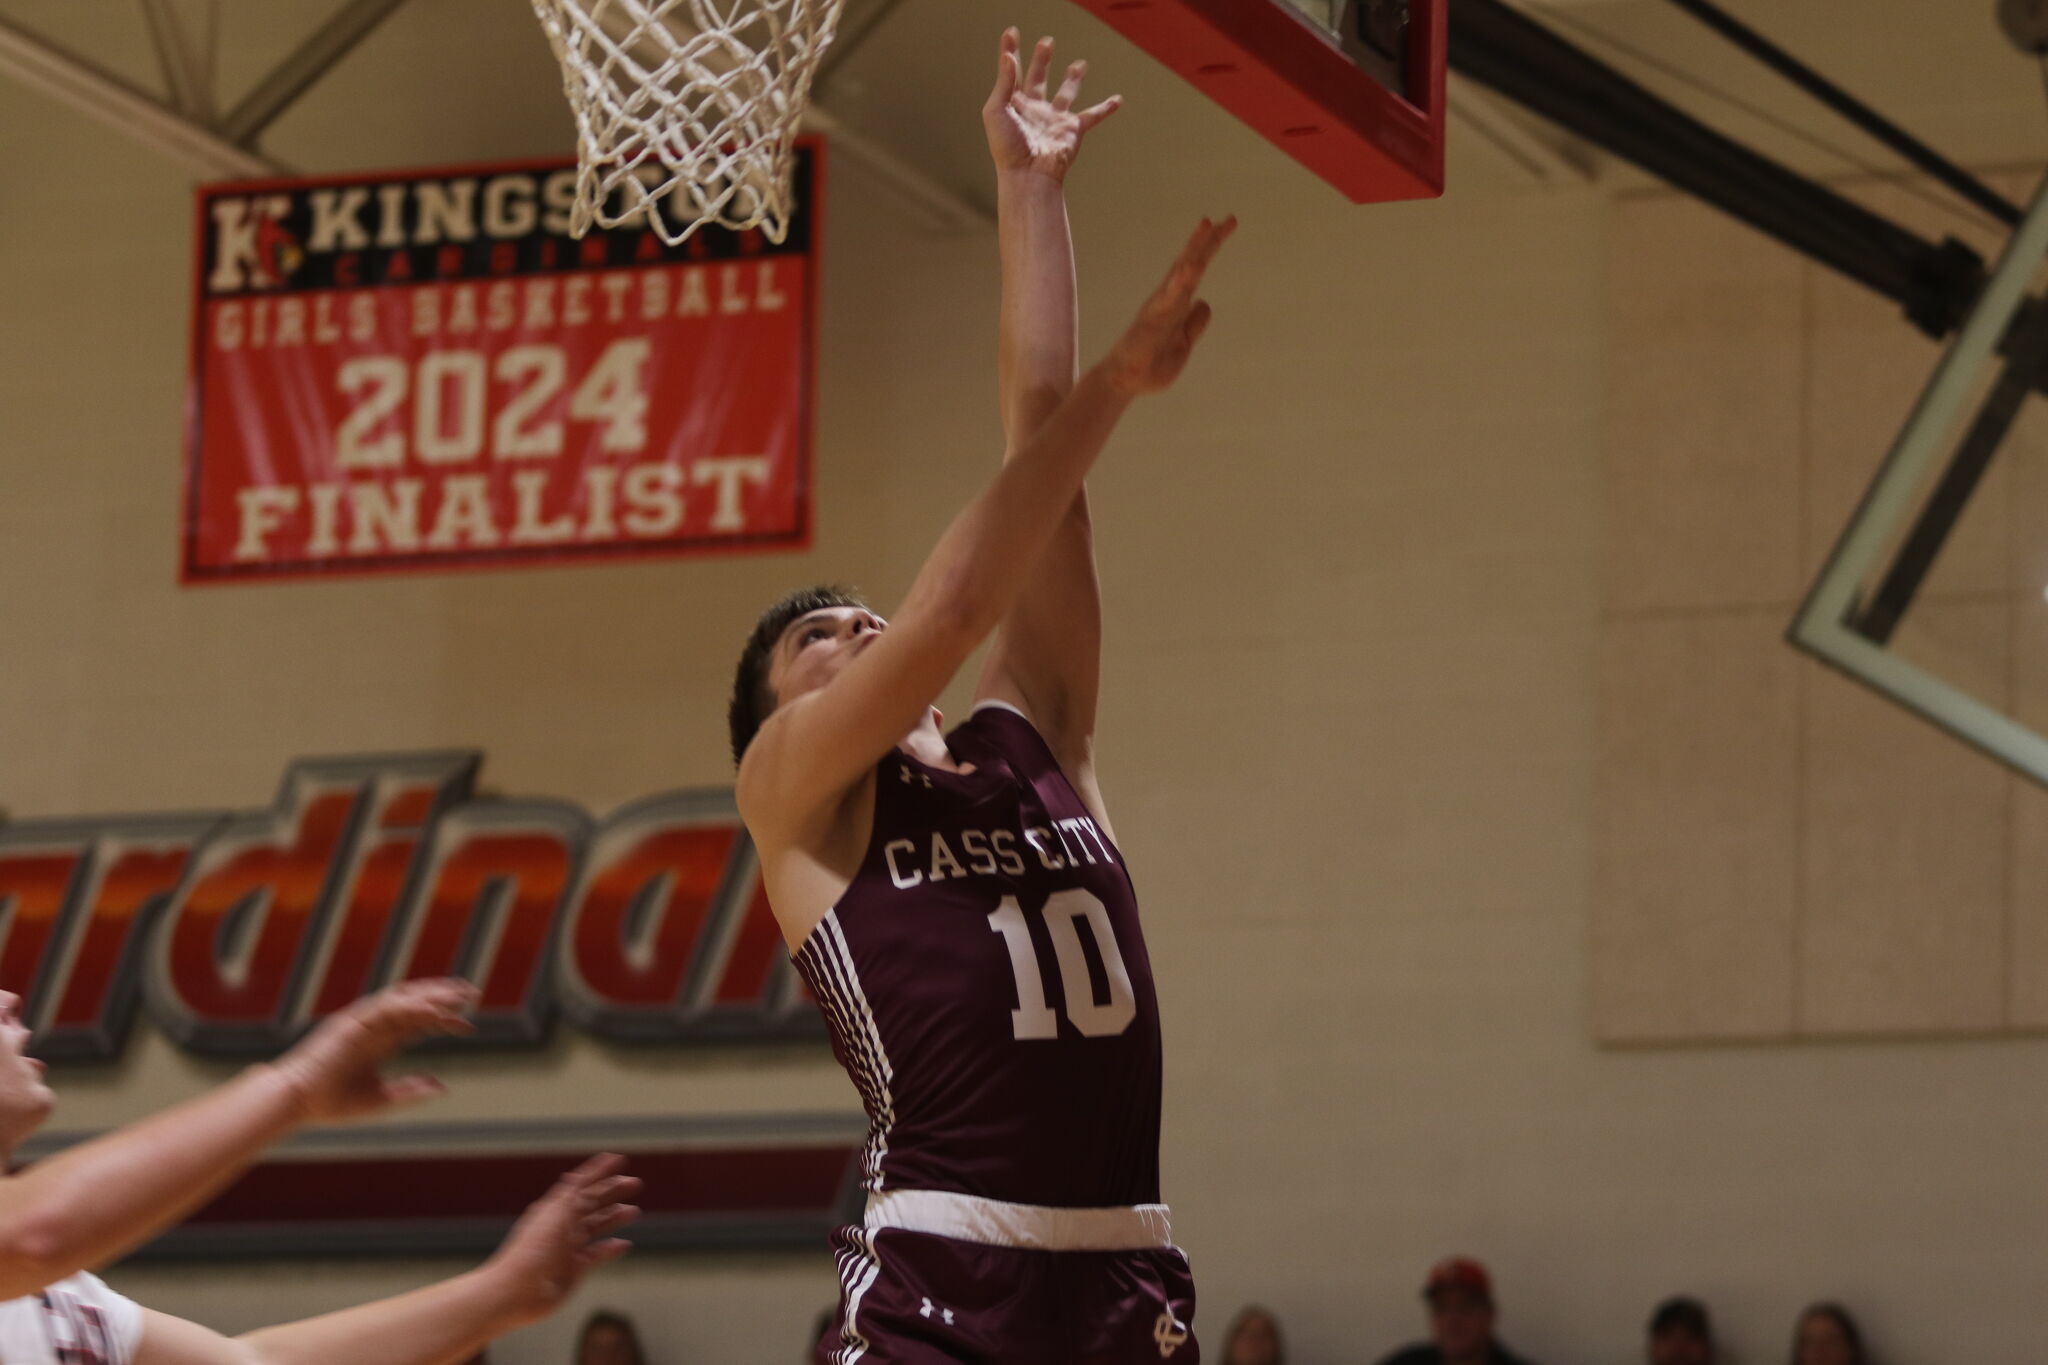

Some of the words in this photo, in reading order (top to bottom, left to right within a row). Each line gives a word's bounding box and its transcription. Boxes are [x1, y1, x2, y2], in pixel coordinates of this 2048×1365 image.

[215, 293, 377, 350] GIRLS
[412, 262, 784, 336] BASKETBALL
[335, 337, 651, 468] 2024
[234, 457, 768, 560] FINALIST
[884, 829, 1024, 889] CASS
[1024, 816, 1114, 869] CITY
[987, 887, 1137, 1041] 10
